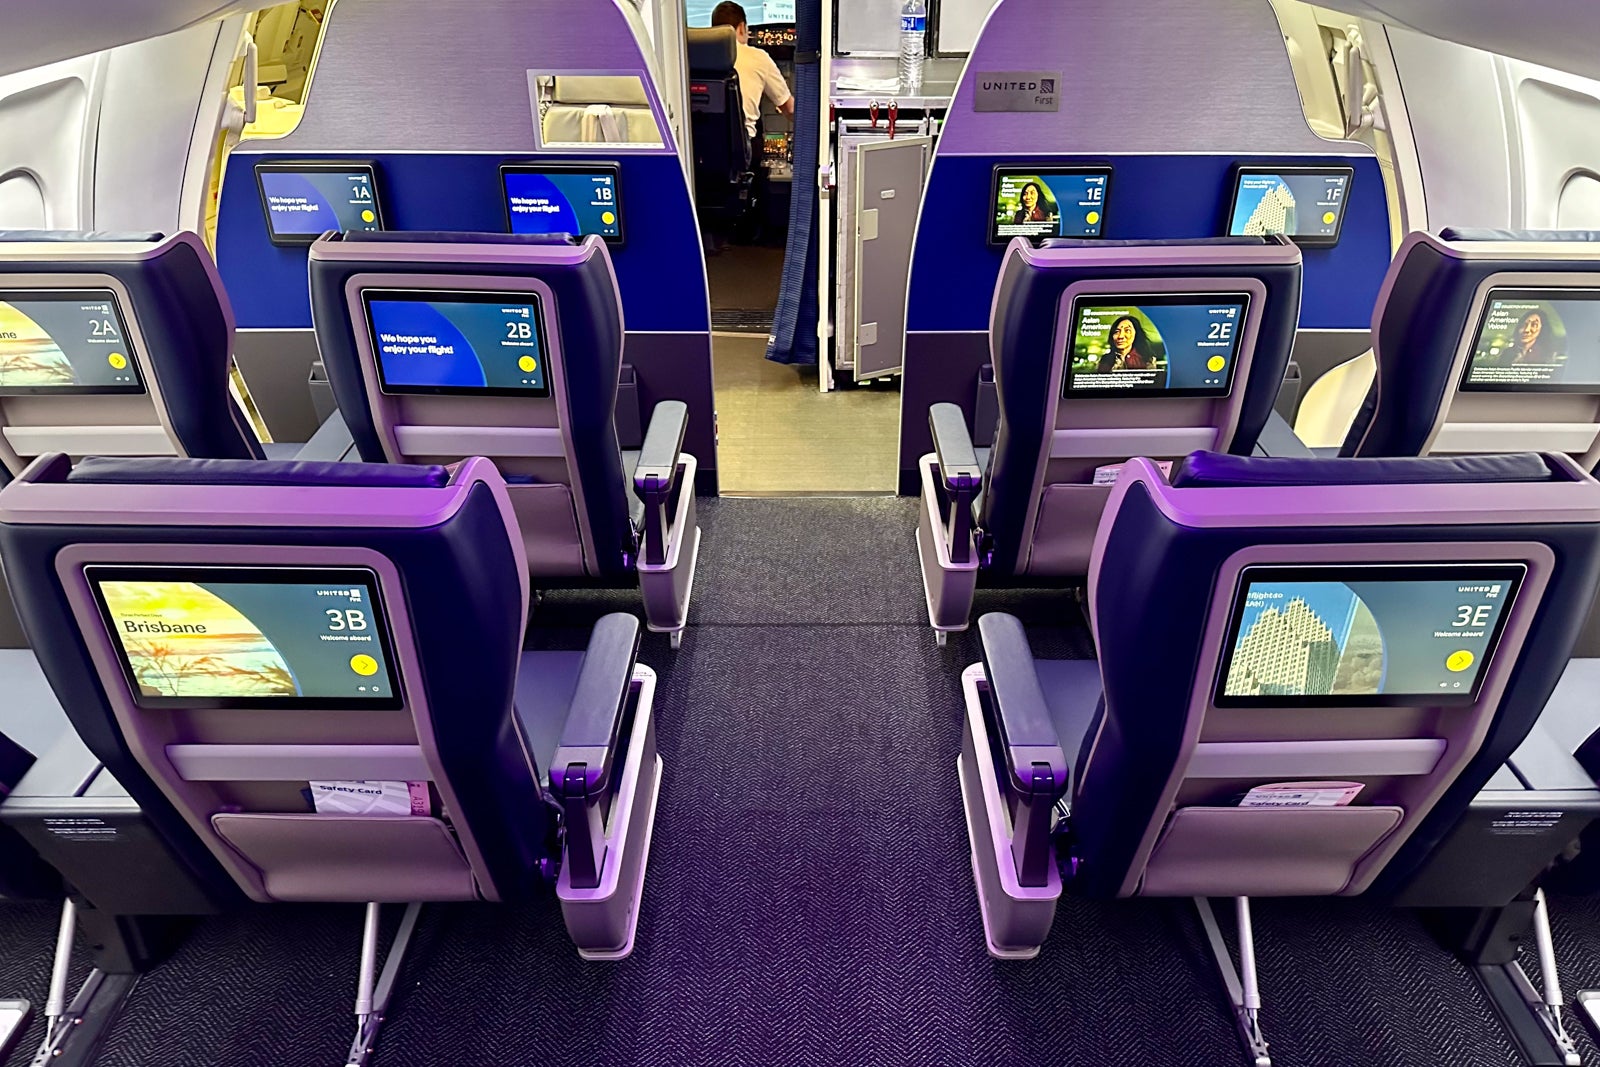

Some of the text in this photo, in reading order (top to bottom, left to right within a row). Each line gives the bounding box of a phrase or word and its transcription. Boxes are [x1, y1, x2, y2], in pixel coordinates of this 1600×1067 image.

[983, 82, 1037, 90] UNITED
[1034, 96, 1053, 105] First
[352, 186, 371, 198] 1A
[595, 188, 612, 200] 1B
[1087, 188, 1102, 200] 1E
[1326, 188, 1342, 200] 1F
[89, 320, 117, 336] 2A
[506, 322, 532, 339] 2B
[1207, 322, 1233, 339] 2E
[380, 334, 437, 345] We hope you
[383, 345, 455, 356] enjoy your flight!
[325, 609, 367, 631] 3B
[1451, 605, 1493, 627] 3E
[123, 620, 207, 633] Brisbane
[319, 785, 355, 793] Safety
